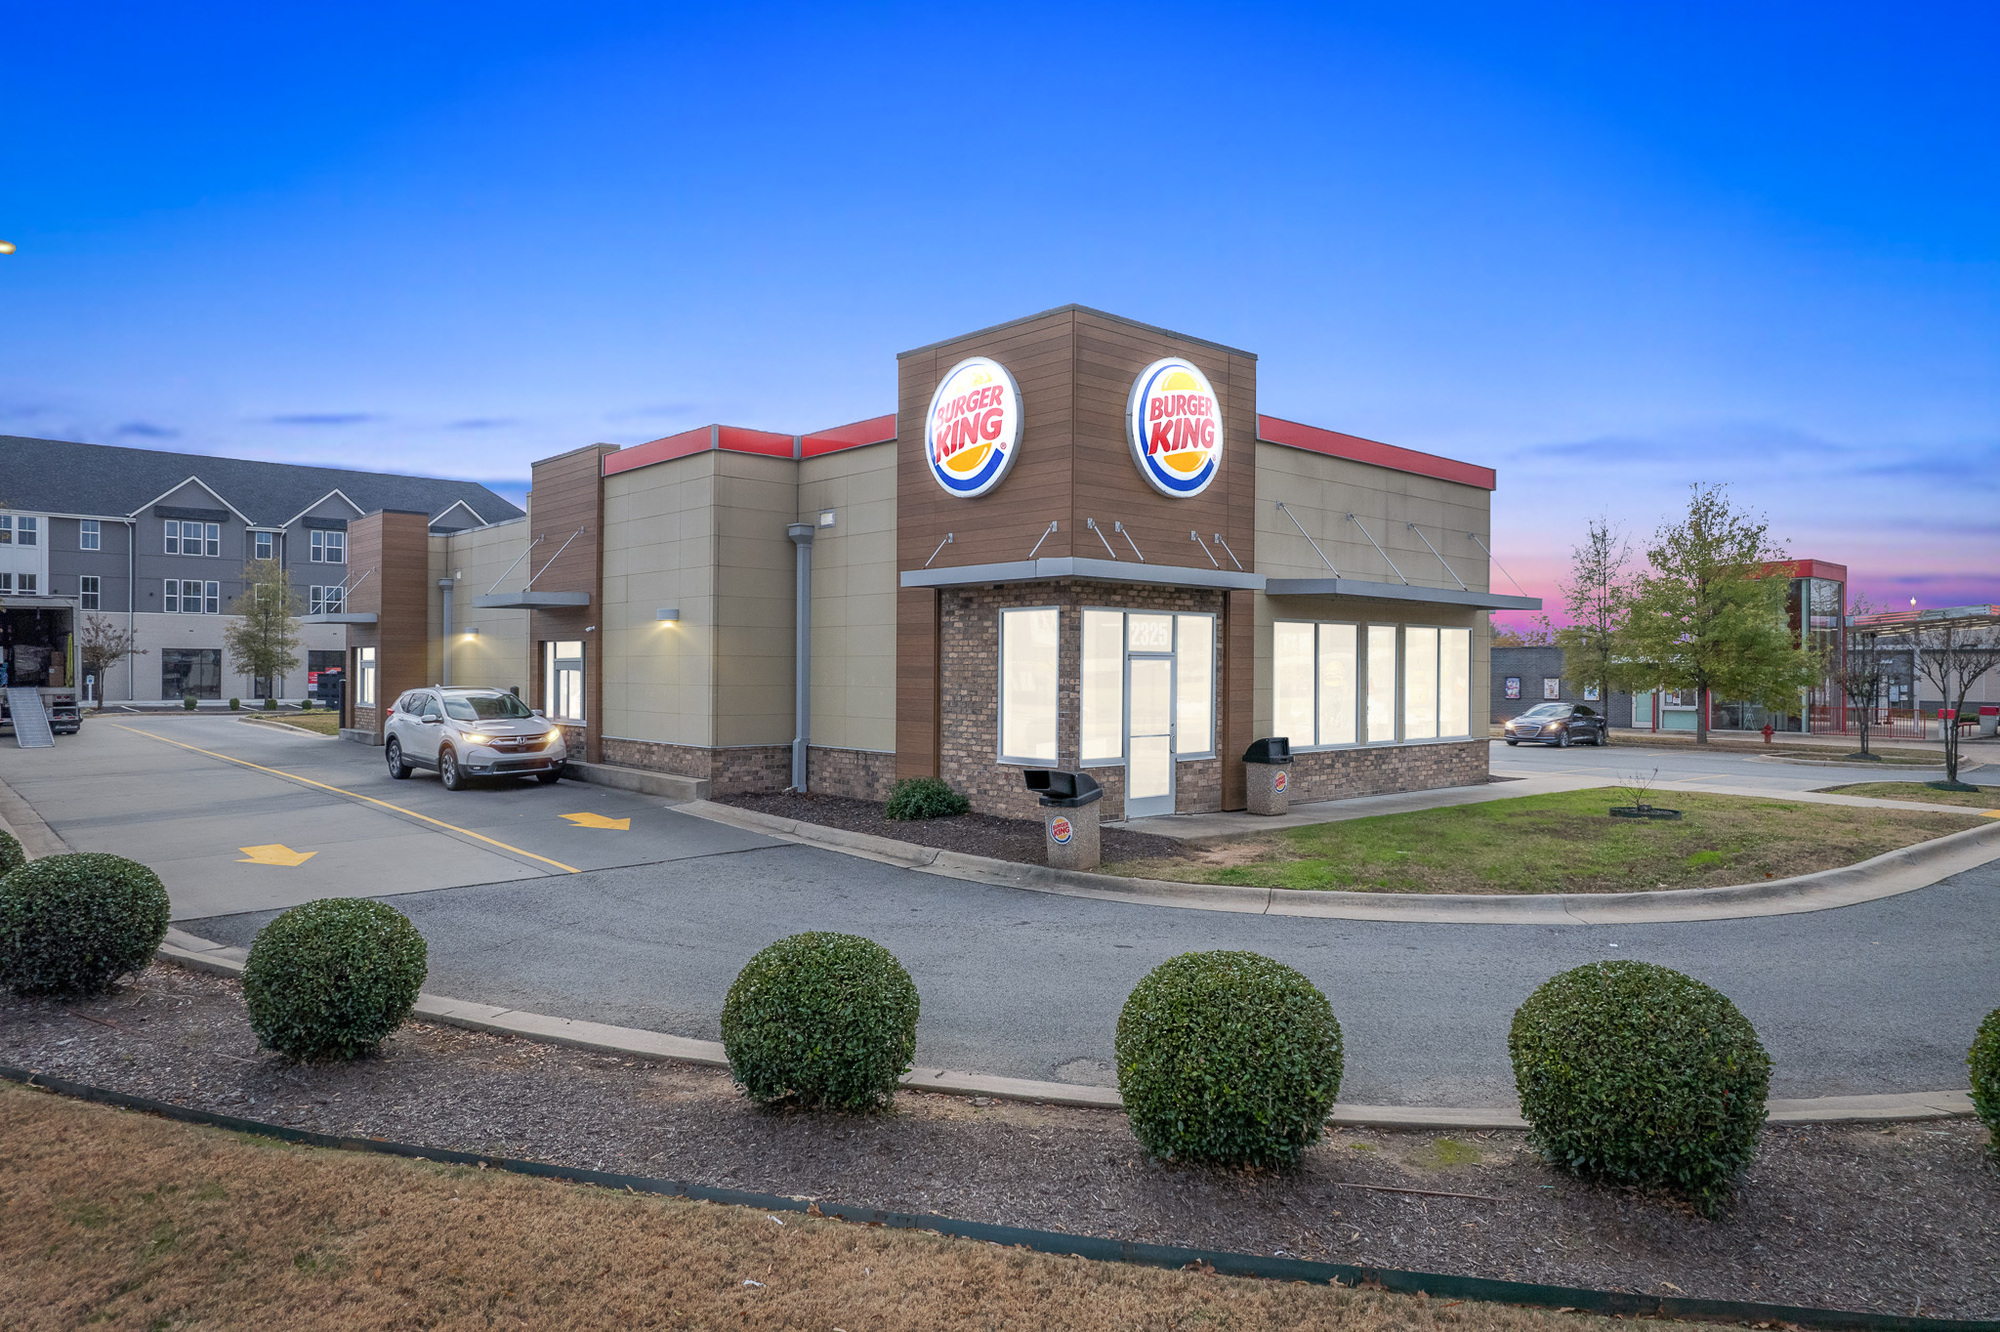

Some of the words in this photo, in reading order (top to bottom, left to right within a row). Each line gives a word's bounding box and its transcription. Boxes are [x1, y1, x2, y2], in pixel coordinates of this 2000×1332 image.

[937, 385, 1003, 431] BURGER
[1150, 394, 1213, 422] BURGER
[936, 407, 1004, 464] KING
[1147, 417, 1215, 456] KING
[1130, 621, 1168, 646] 2325
[1053, 827, 1070, 836] KING
